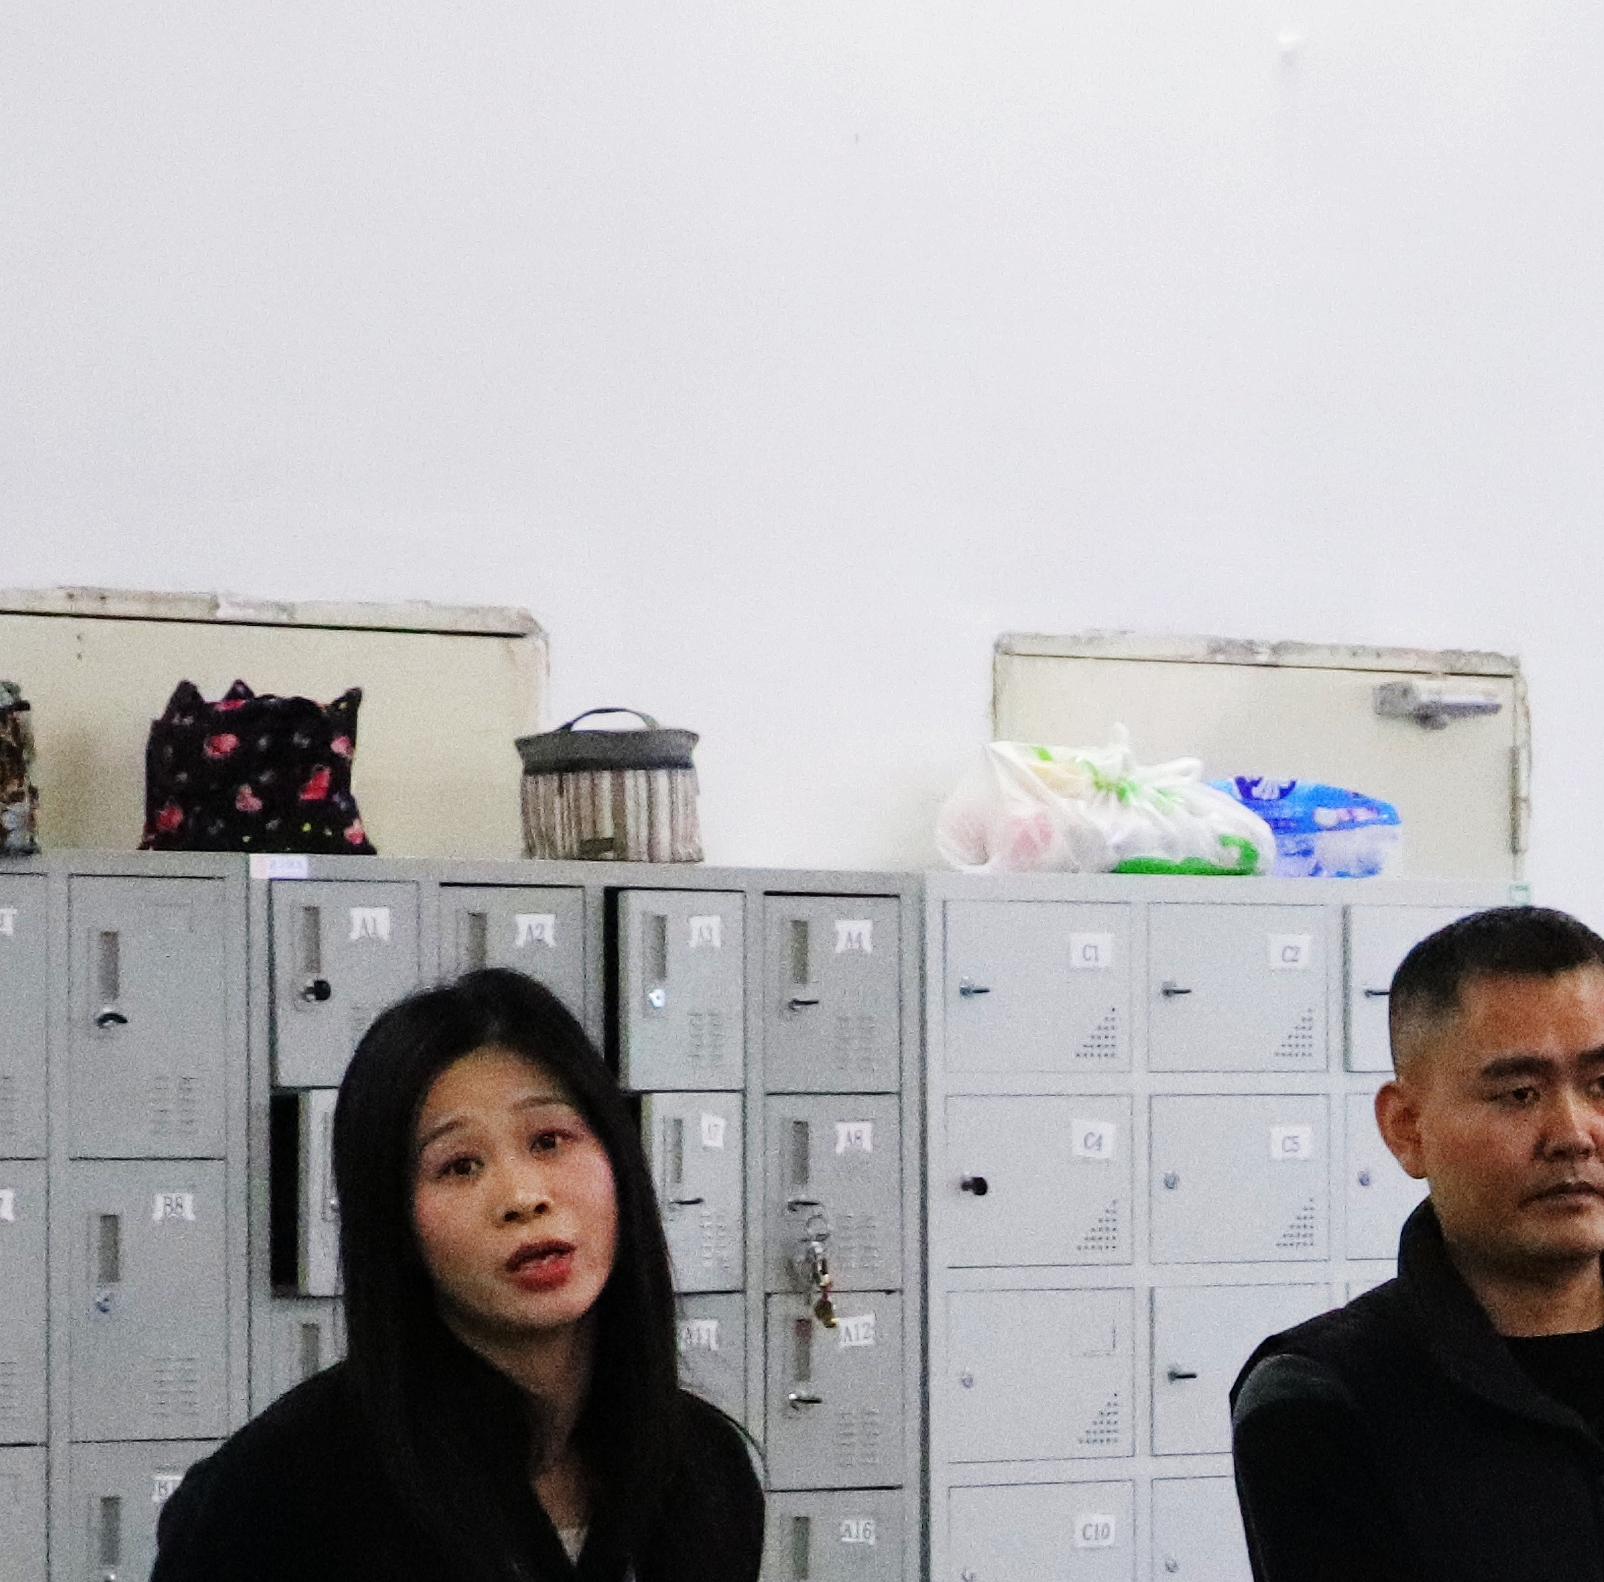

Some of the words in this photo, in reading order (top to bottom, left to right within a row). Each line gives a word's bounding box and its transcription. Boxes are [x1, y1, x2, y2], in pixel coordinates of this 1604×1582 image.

[1082, 943, 1100, 962] C1
[1281, 945, 1300, 963] C2
[1083, 1131, 1103, 1151] C4
[842, 1322, 873, 1343] A12
[842, 1519, 874, 1541] A16
[1081, 1522, 1111, 1542] C10
